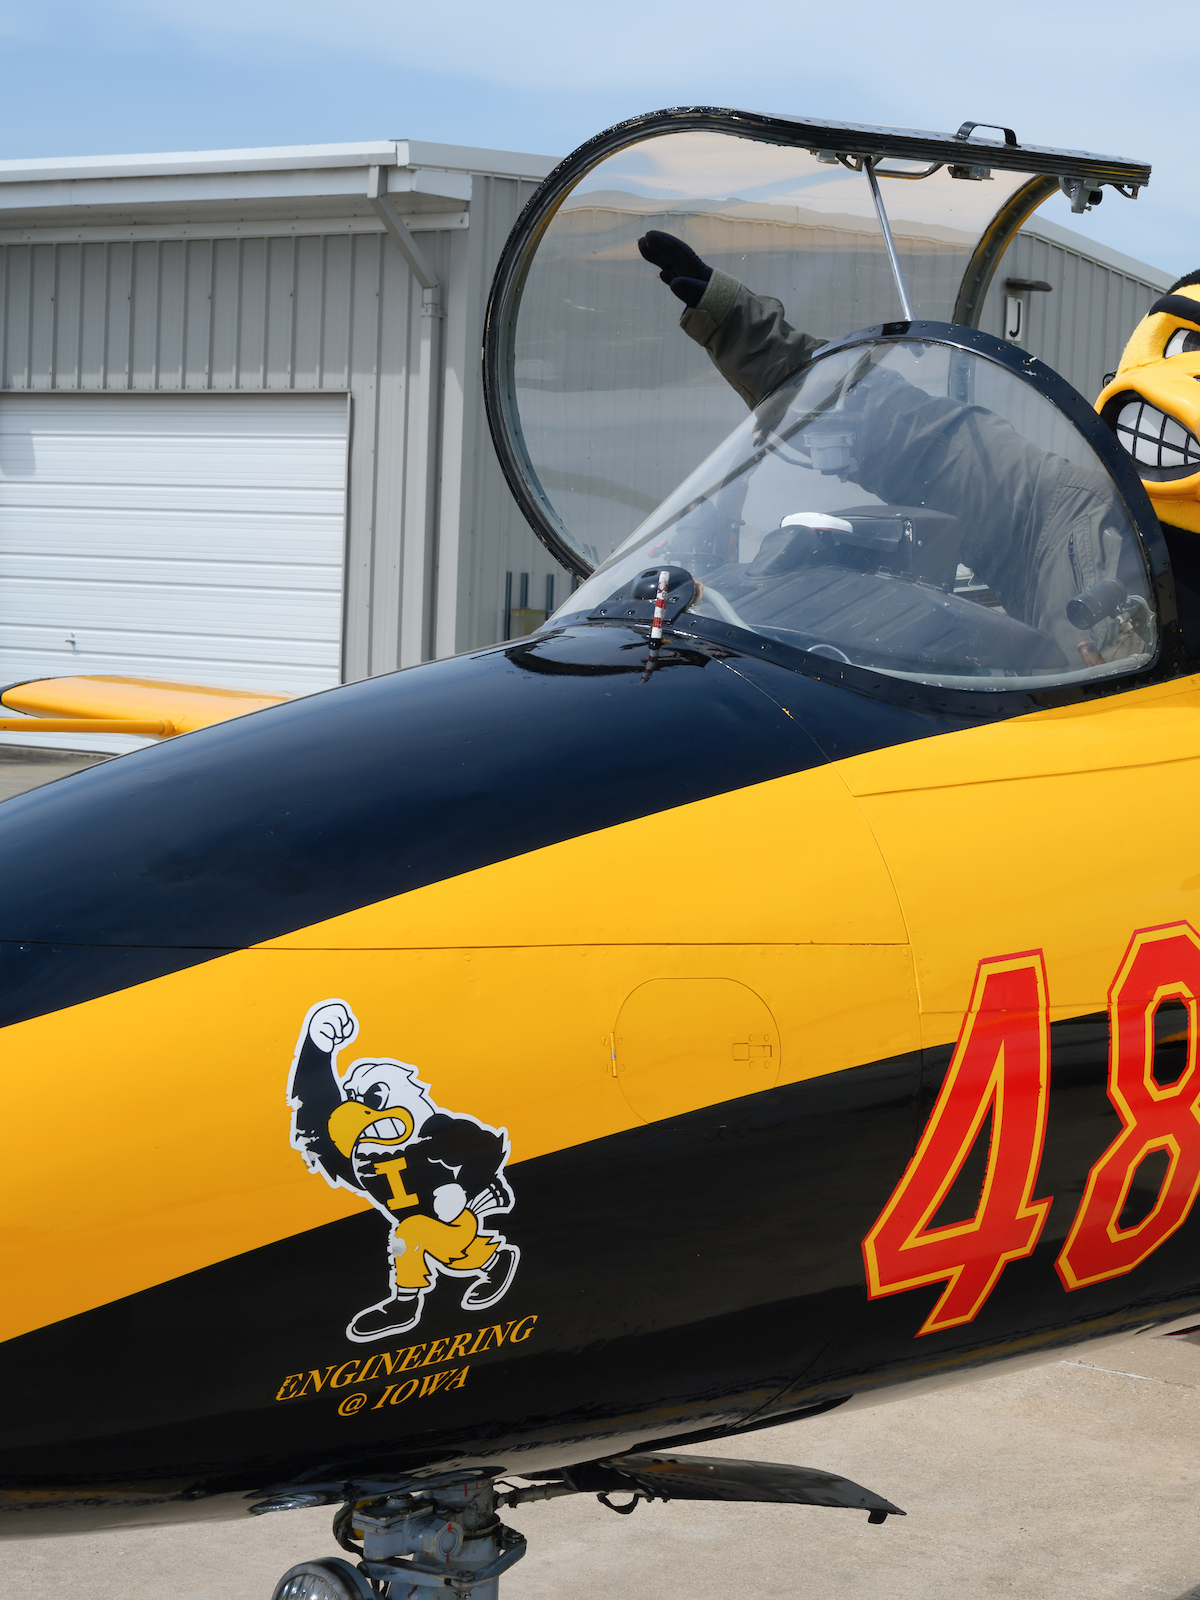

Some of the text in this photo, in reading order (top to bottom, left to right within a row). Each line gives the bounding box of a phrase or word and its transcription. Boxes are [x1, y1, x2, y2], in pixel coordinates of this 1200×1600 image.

[1008, 301, 1021, 338] J
[373, 1156, 420, 1211] I
[275, 1314, 539, 1401] ENGINEERING
[337, 1365, 470, 1417] @ IOWA
